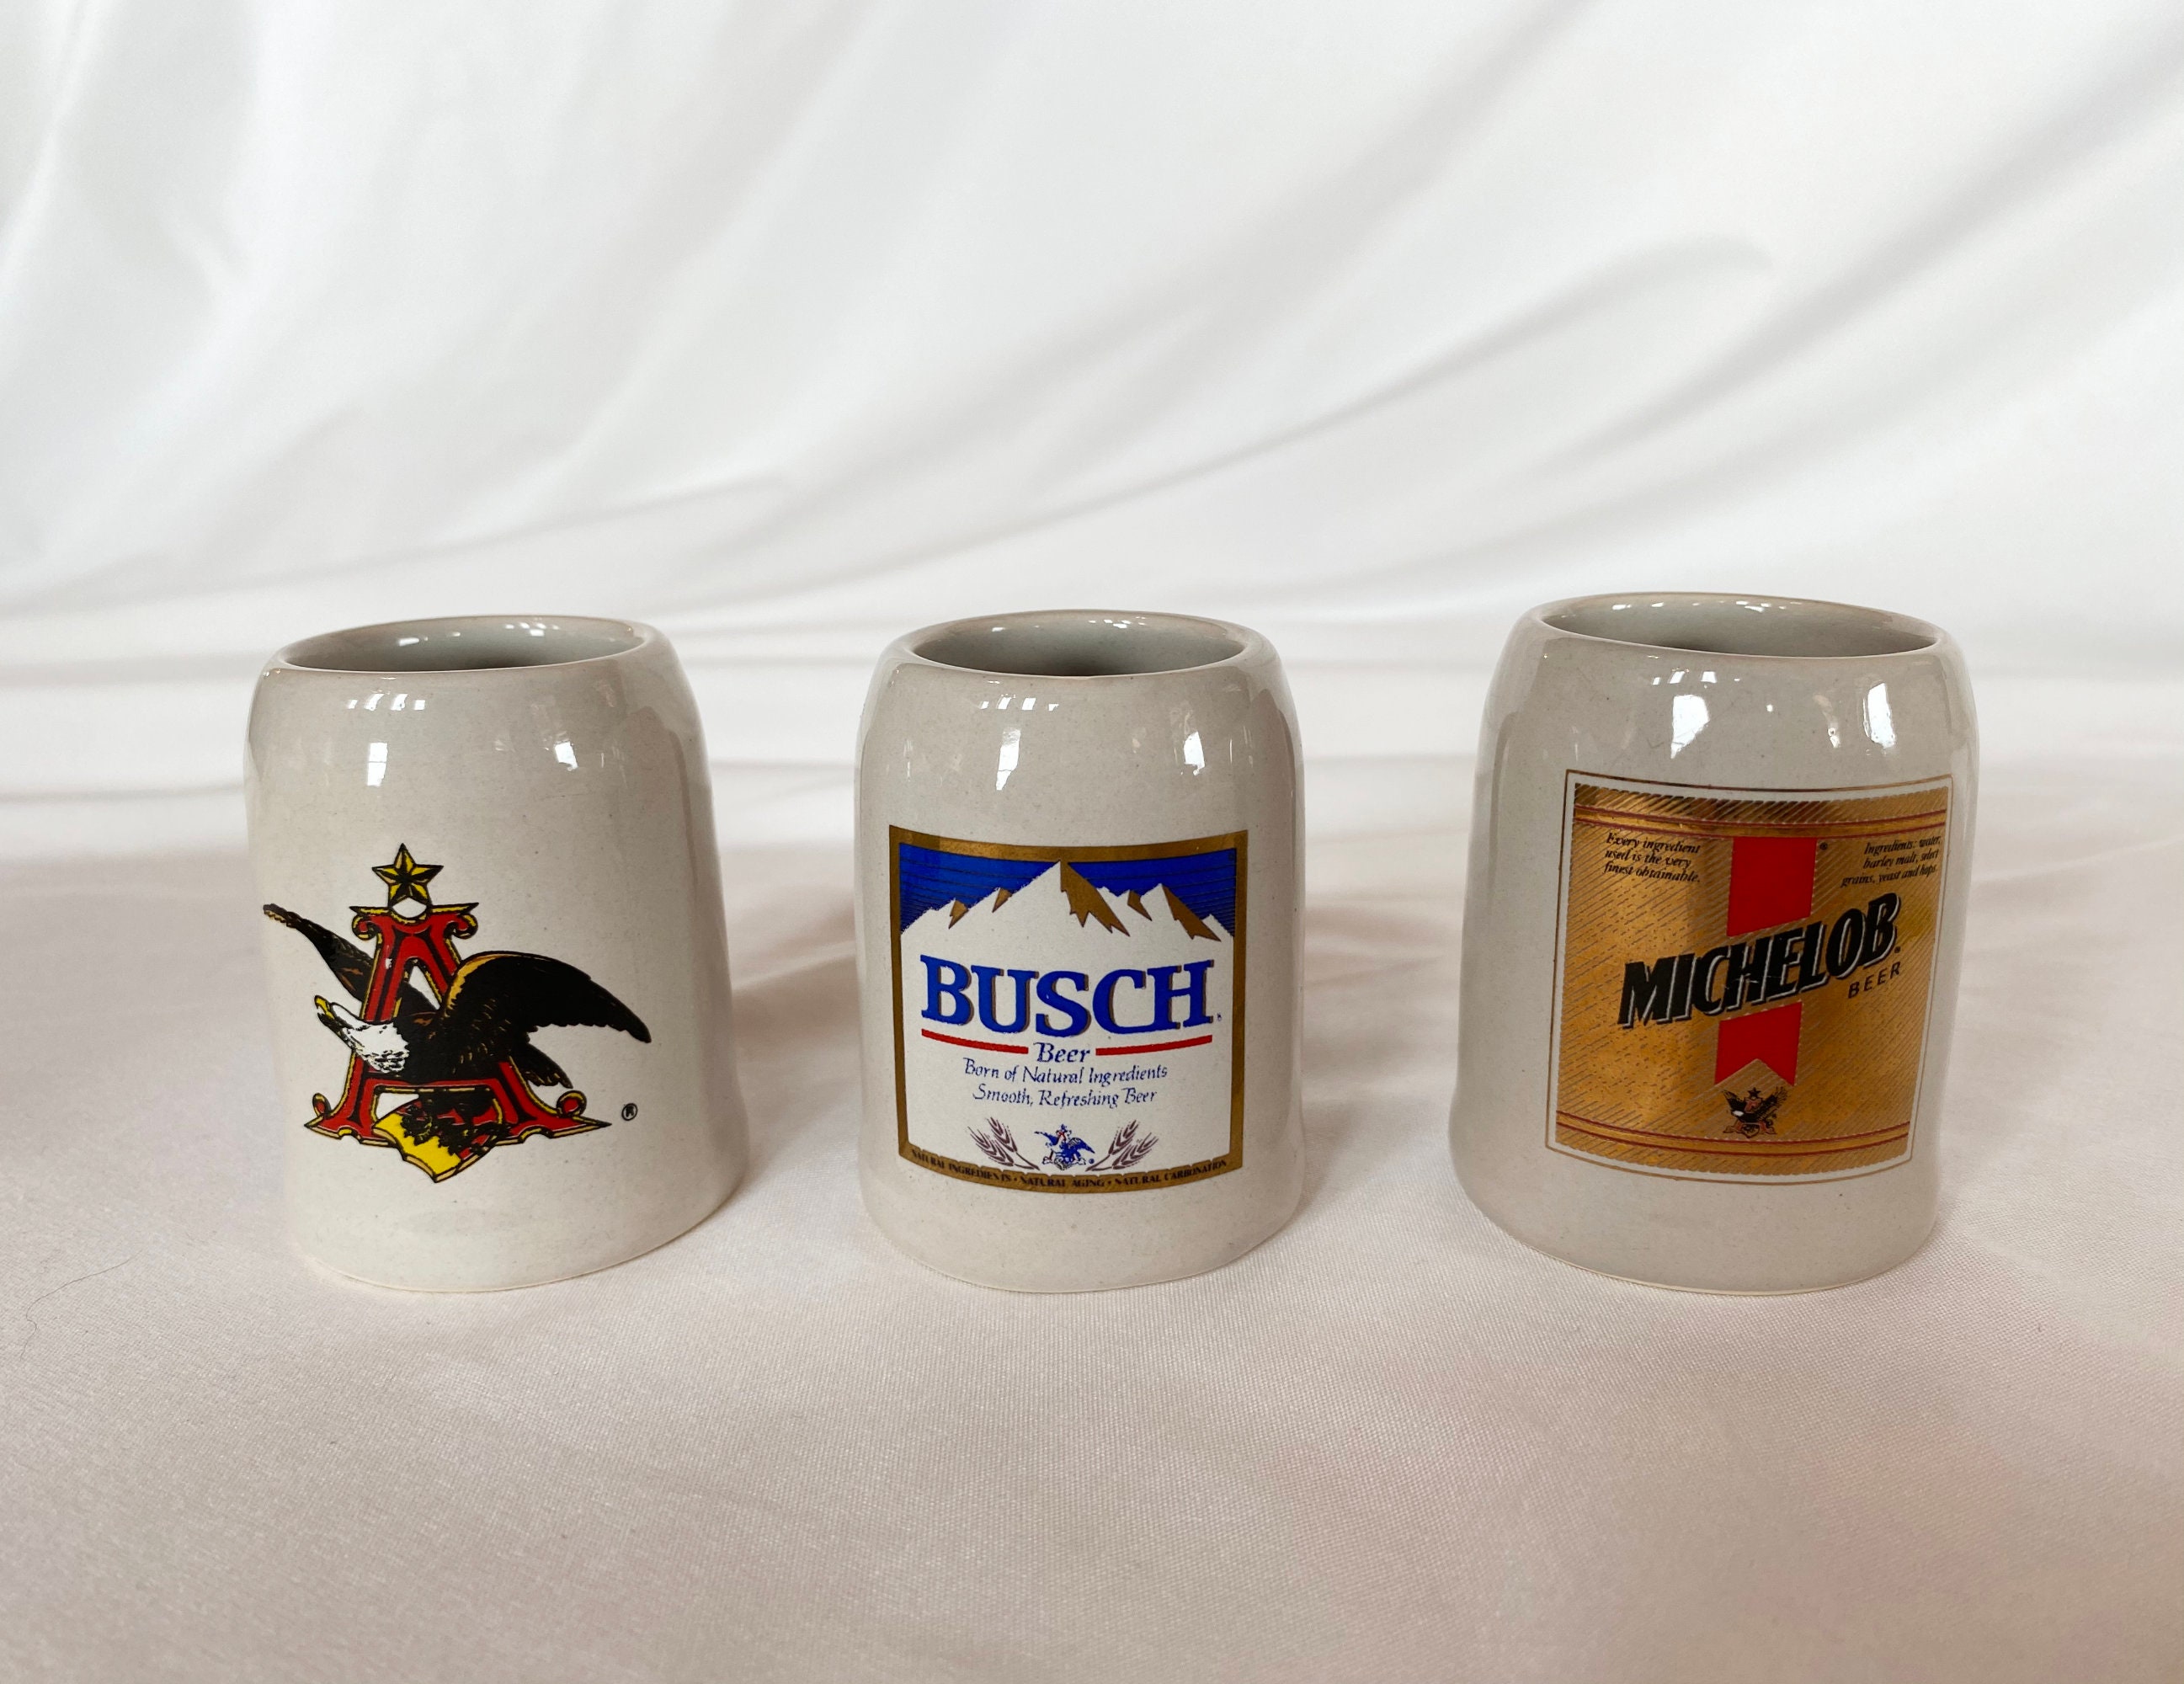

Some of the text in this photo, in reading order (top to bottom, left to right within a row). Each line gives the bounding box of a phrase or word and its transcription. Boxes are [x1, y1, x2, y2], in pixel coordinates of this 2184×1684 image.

[1606, 833, 1700, 853] Every ingredient
[1605, 848, 1691, 869] used is the very
[1863, 855, 1893, 869] barley
[1603, 861, 1701, 882] finest obtainable.
[1878, 871, 1901, 884] yeast
[1901, 866, 1920, 879] and
[1617, 893, 1901, 1029] MICHELOB
[1847, 962, 1902, 999] BEER
[920, 954, 1214, 1037] BUSCH
[1033, 1042, 1090, 1063] Beer
[963, 1057, 1168, 1087] Born of Natural Ingredients
[972, 1083, 1158, 1109] Smooth, Refreshing Beer
[911, 1149, 1227, 1187] NATURAL INGREDIENTS NATURAL AGING NATURAL CARBONATION
